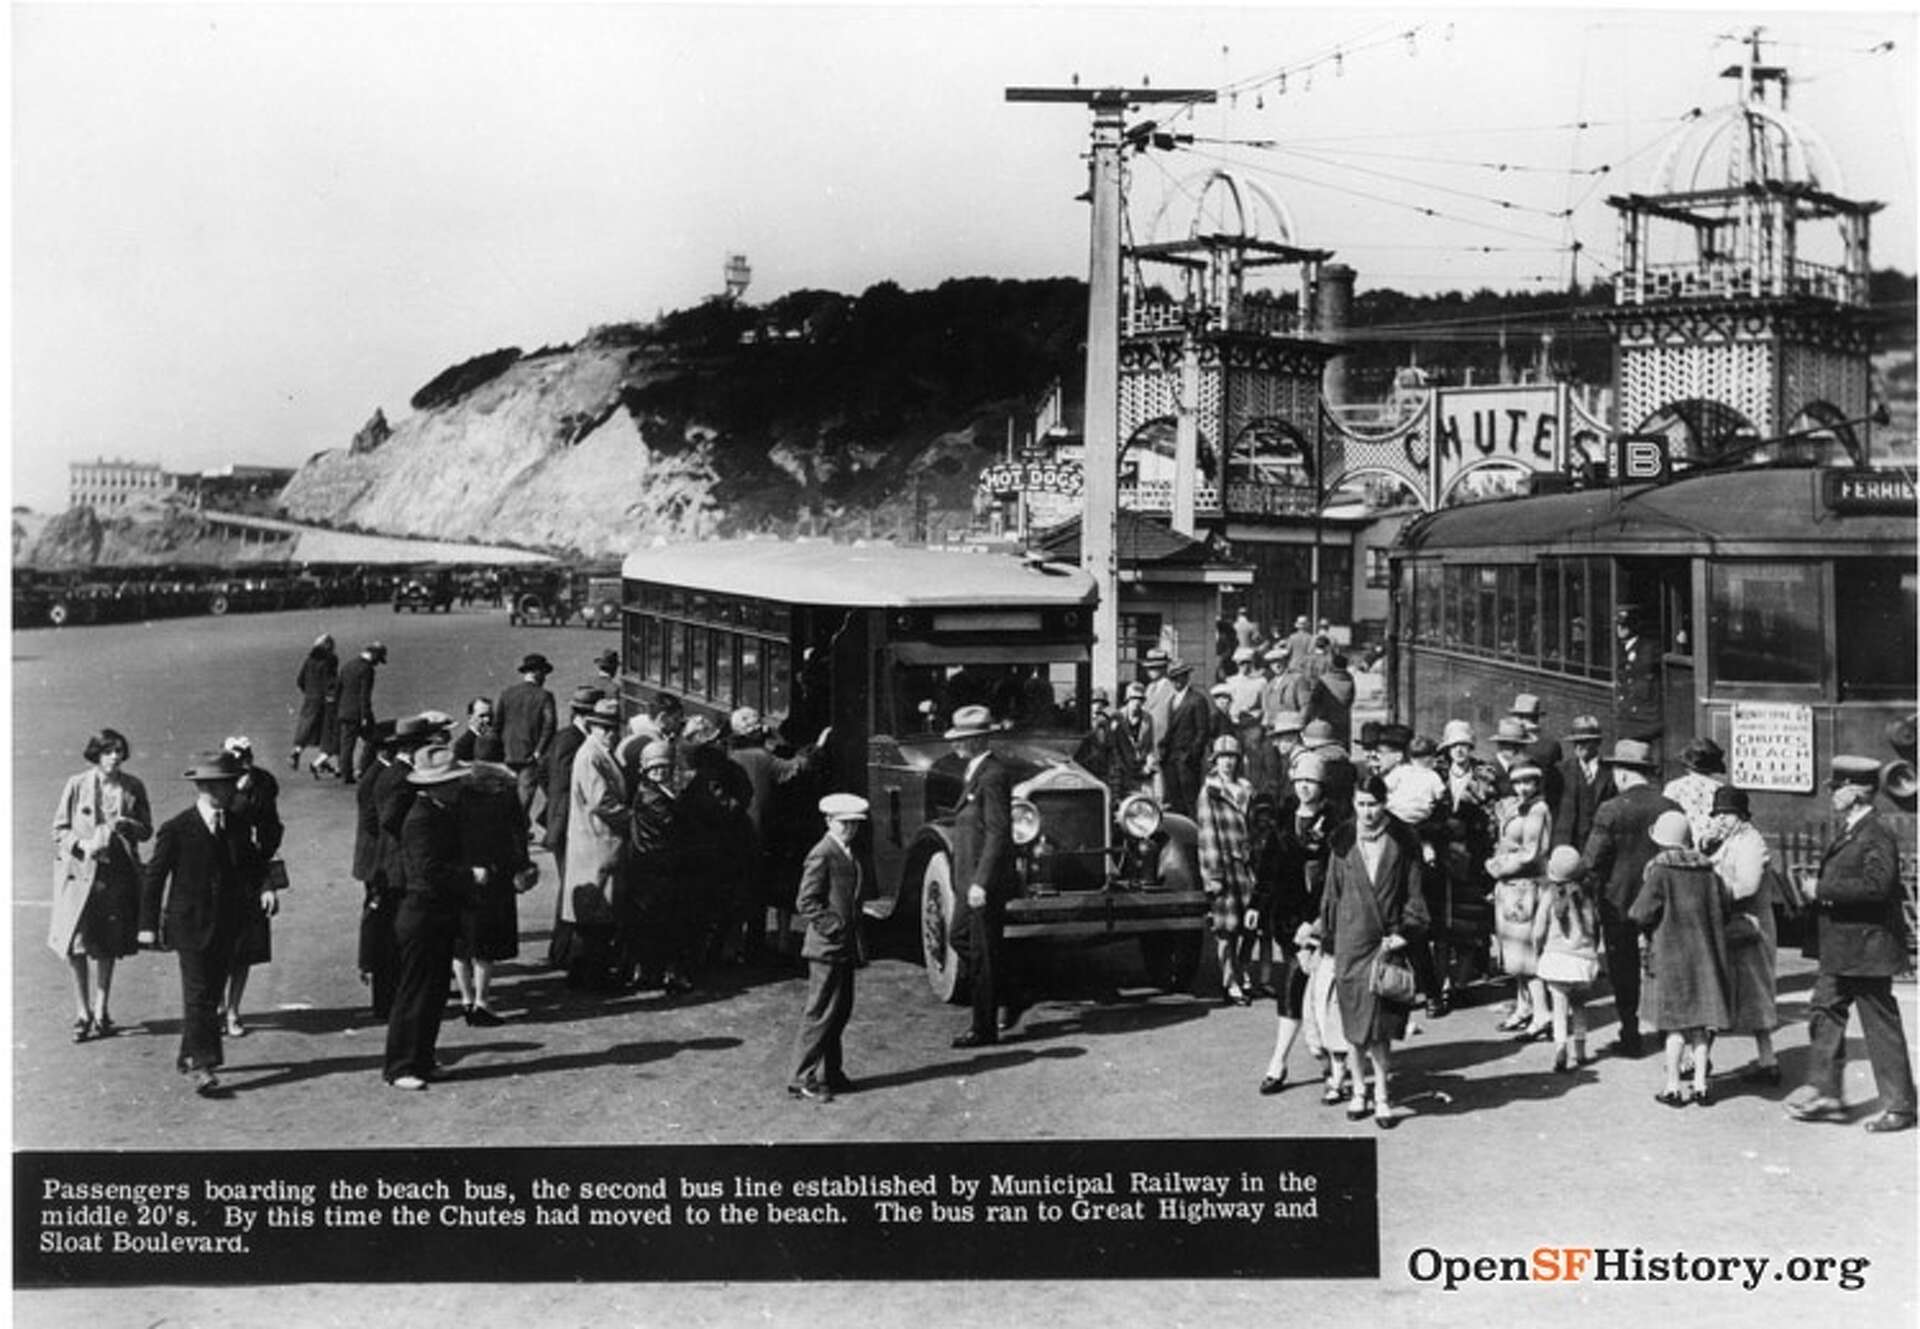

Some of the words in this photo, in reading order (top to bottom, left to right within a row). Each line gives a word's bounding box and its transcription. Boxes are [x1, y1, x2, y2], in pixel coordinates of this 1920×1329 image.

[1404, 408, 1600, 481] CHUTES
[1627, 442, 1662, 477] B
[984, 470, 1022, 488] HOT
[1031, 471, 1081, 489] DOGS
[1736, 734, 1808, 748] CHUTES
[1736, 747, 1810, 758] BEACH
